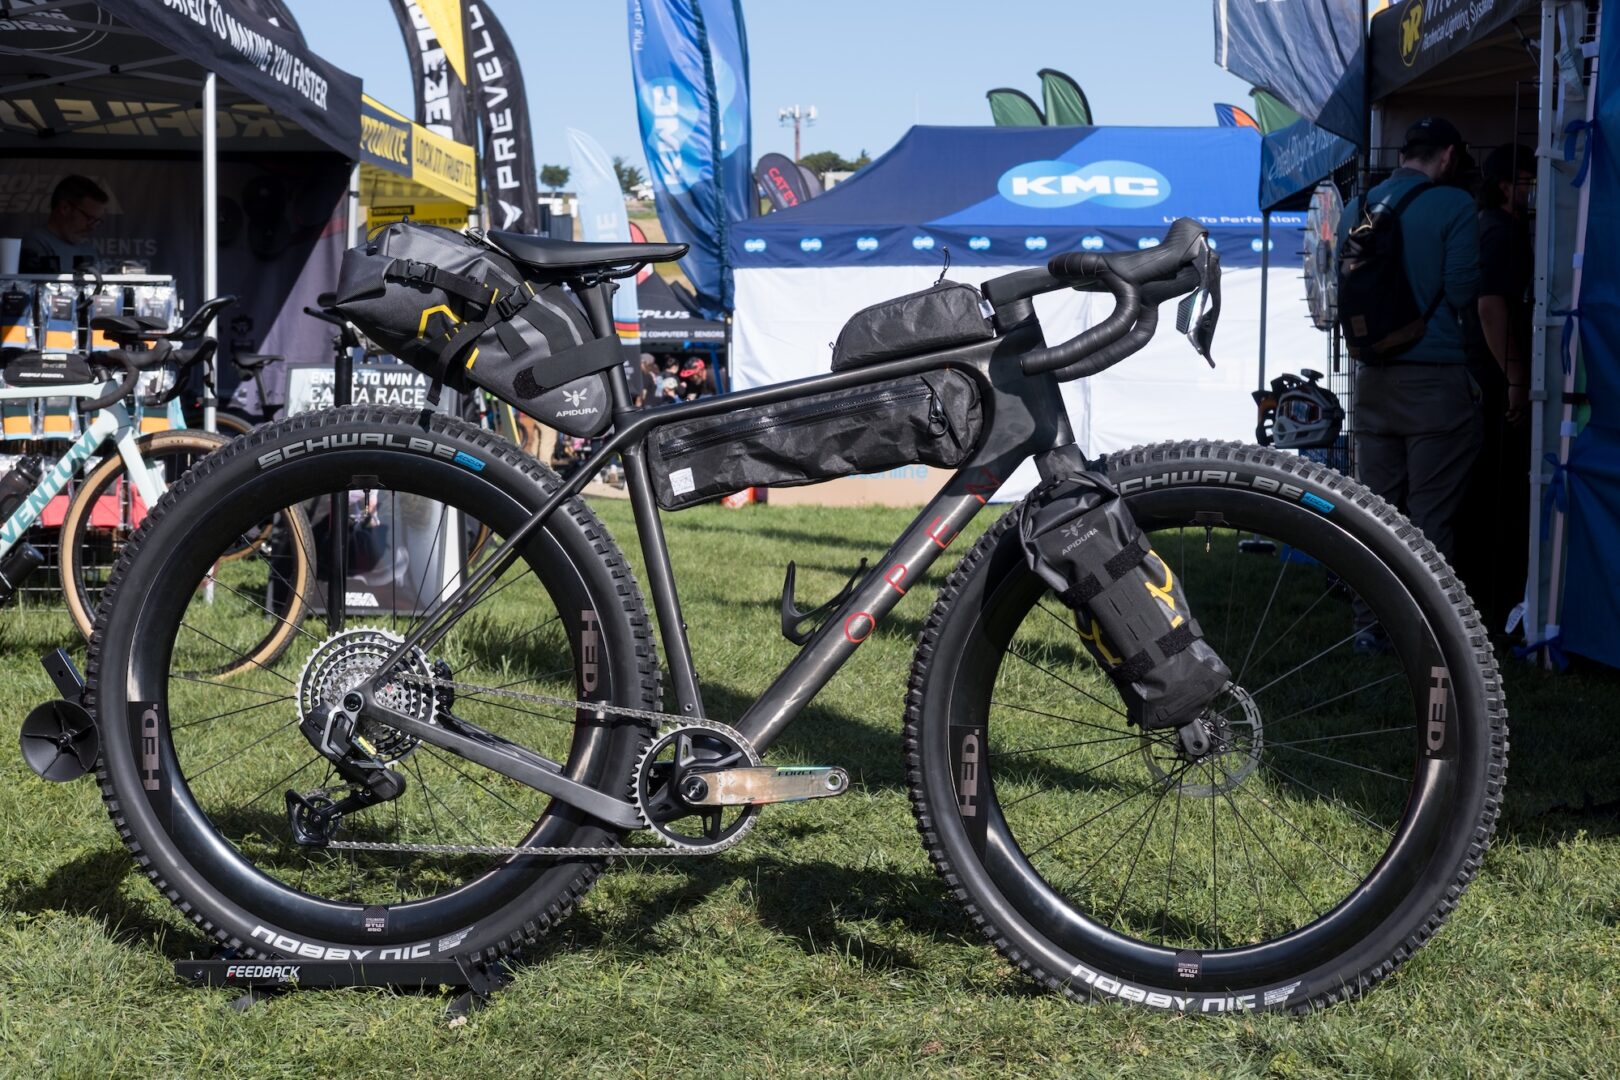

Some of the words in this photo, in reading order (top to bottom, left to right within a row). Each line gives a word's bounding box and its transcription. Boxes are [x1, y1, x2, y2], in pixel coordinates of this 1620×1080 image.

[210, 2, 227, 39] TO
[226, 13, 273, 72] MAKING
[269, 45, 294, 86] YOU
[292, 57, 328, 111] FASTER
[1012, 175, 1159, 196] KMC
[1220, 215, 1301, 224] Perfetion
[80, 238, 158, 257] NENTS
[648, 330, 689, 338] COMPUTERS
[694, 330, 725, 339] SENSORS
[361, 373, 381, 385] TO
[383, 372, 412, 386] WIN
[414, 373, 426, 387] A
[310, 387, 369, 404] CATA
[375, 387, 425, 405] RACE
[555, 407, 599, 418] APIDURA
[257, 432, 456, 470] SCHWALBE
[0, 431, 98, 544] VENTUM
[1062, 528, 1098, 556] APIDURA
[844, 467, 1002, 643] OPEN
[250, 925, 373, 961] NOBBY
[379, 942, 431, 961] NIC
[226, 965, 300, 978] FEEDBACK
[1071, 964, 1195, 1011] NOBBY
[1202, 994, 1256, 1012] NIC
